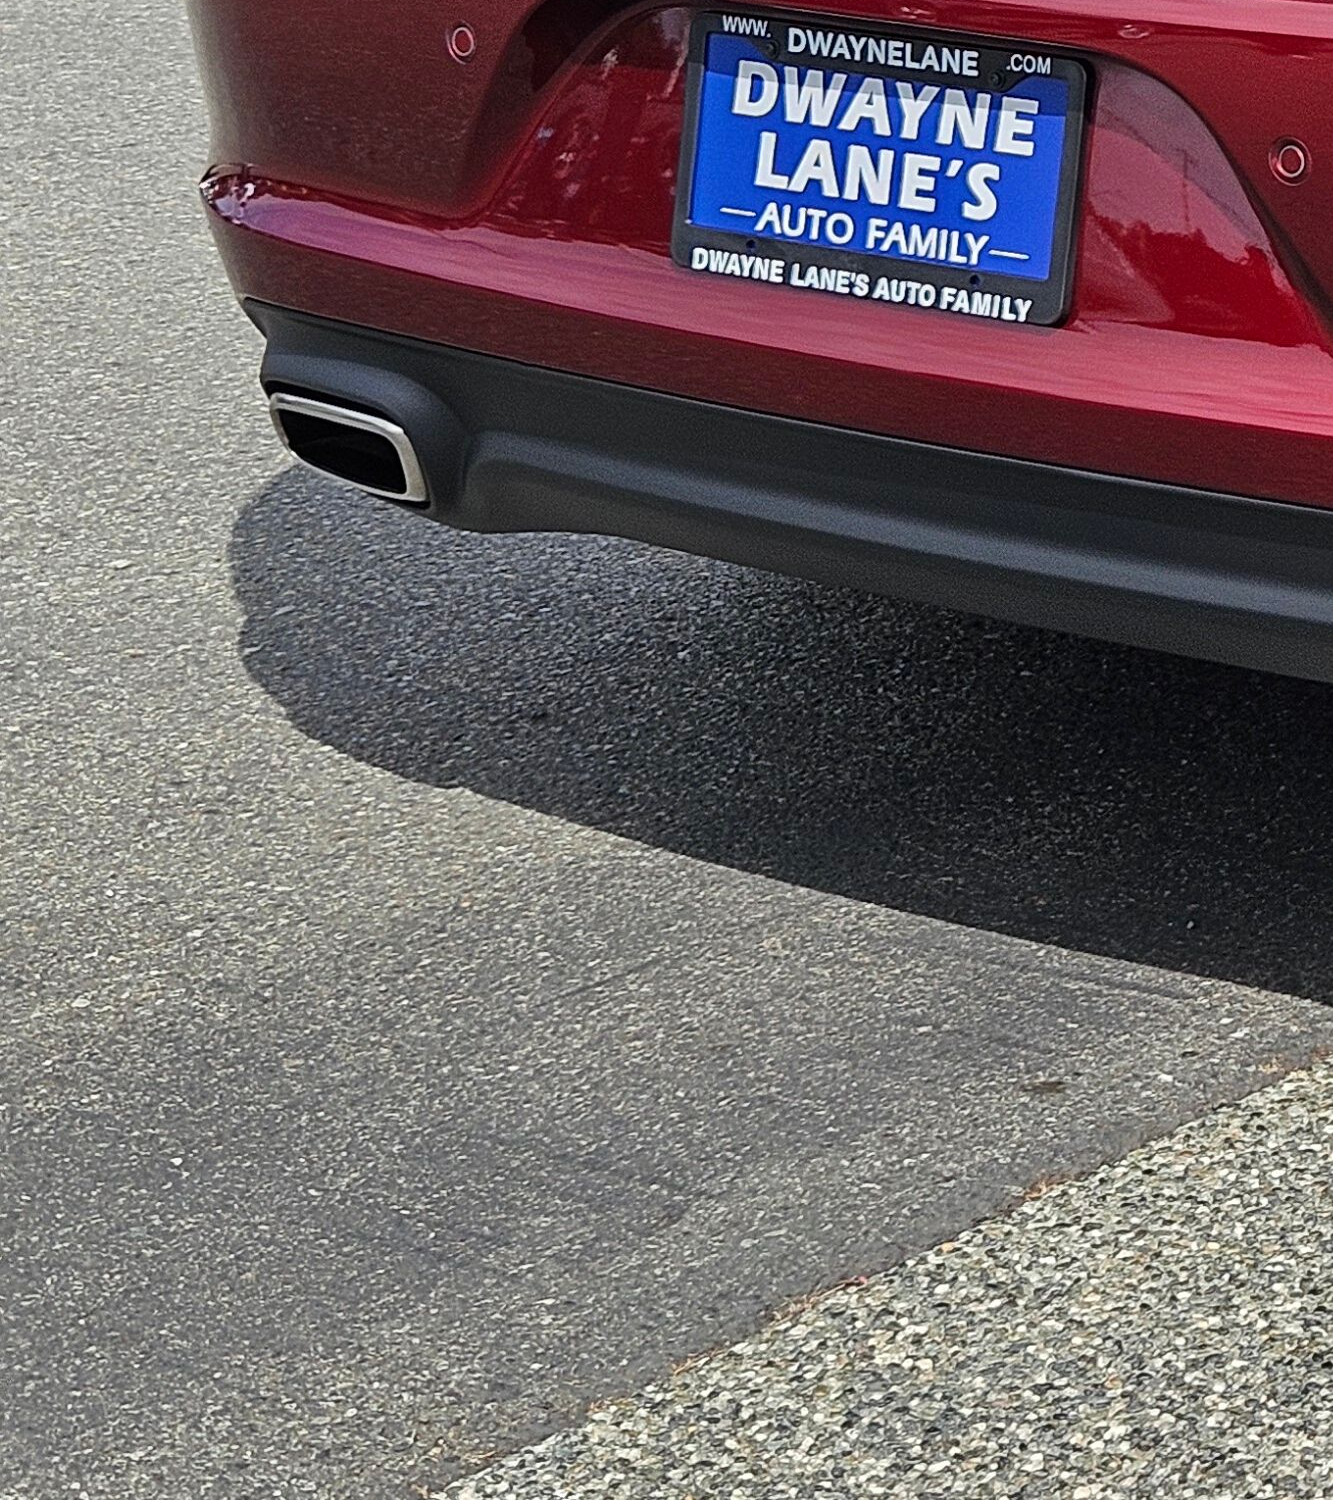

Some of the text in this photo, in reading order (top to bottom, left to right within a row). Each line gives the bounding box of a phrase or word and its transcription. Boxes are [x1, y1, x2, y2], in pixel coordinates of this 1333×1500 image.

[722, 14, 1052, 77] WWW. DWAYNELANE .COM
[731, 58, 1040, 157] DWAYNE
[753, 130, 1001, 222] LANE'S
[754, 201, 991, 267] AUTO FAMILY
[691, 246, 1034, 324] DWAYNE LANE'S AUTO FAMILY
